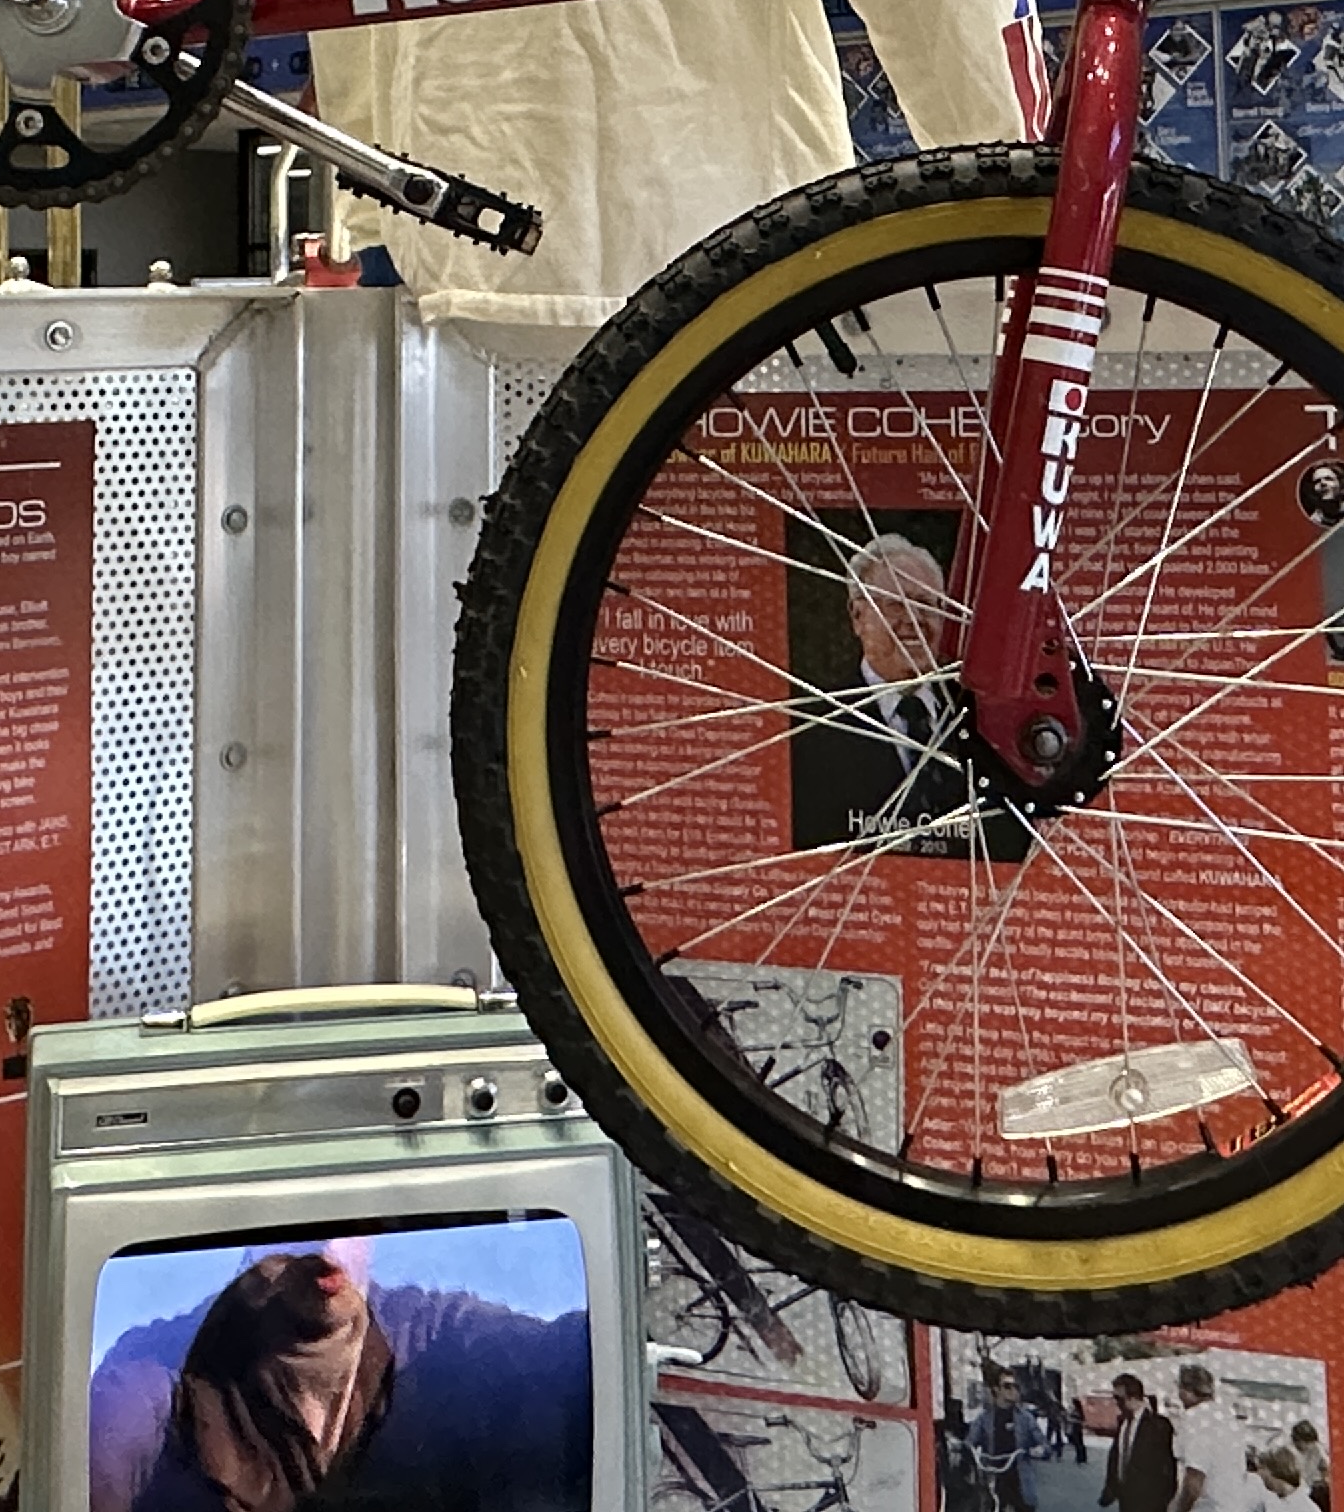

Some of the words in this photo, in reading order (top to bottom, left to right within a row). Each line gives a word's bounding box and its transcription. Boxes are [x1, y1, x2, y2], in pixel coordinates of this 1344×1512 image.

[847, 406, 987, 438] COHE
[741, 442, 832, 464] KUWAHARA
[615, 607, 643, 630] fall
[648, 608, 665, 631] in
[715, 610, 754, 632] with
[642, 633, 707, 660] bicycle
